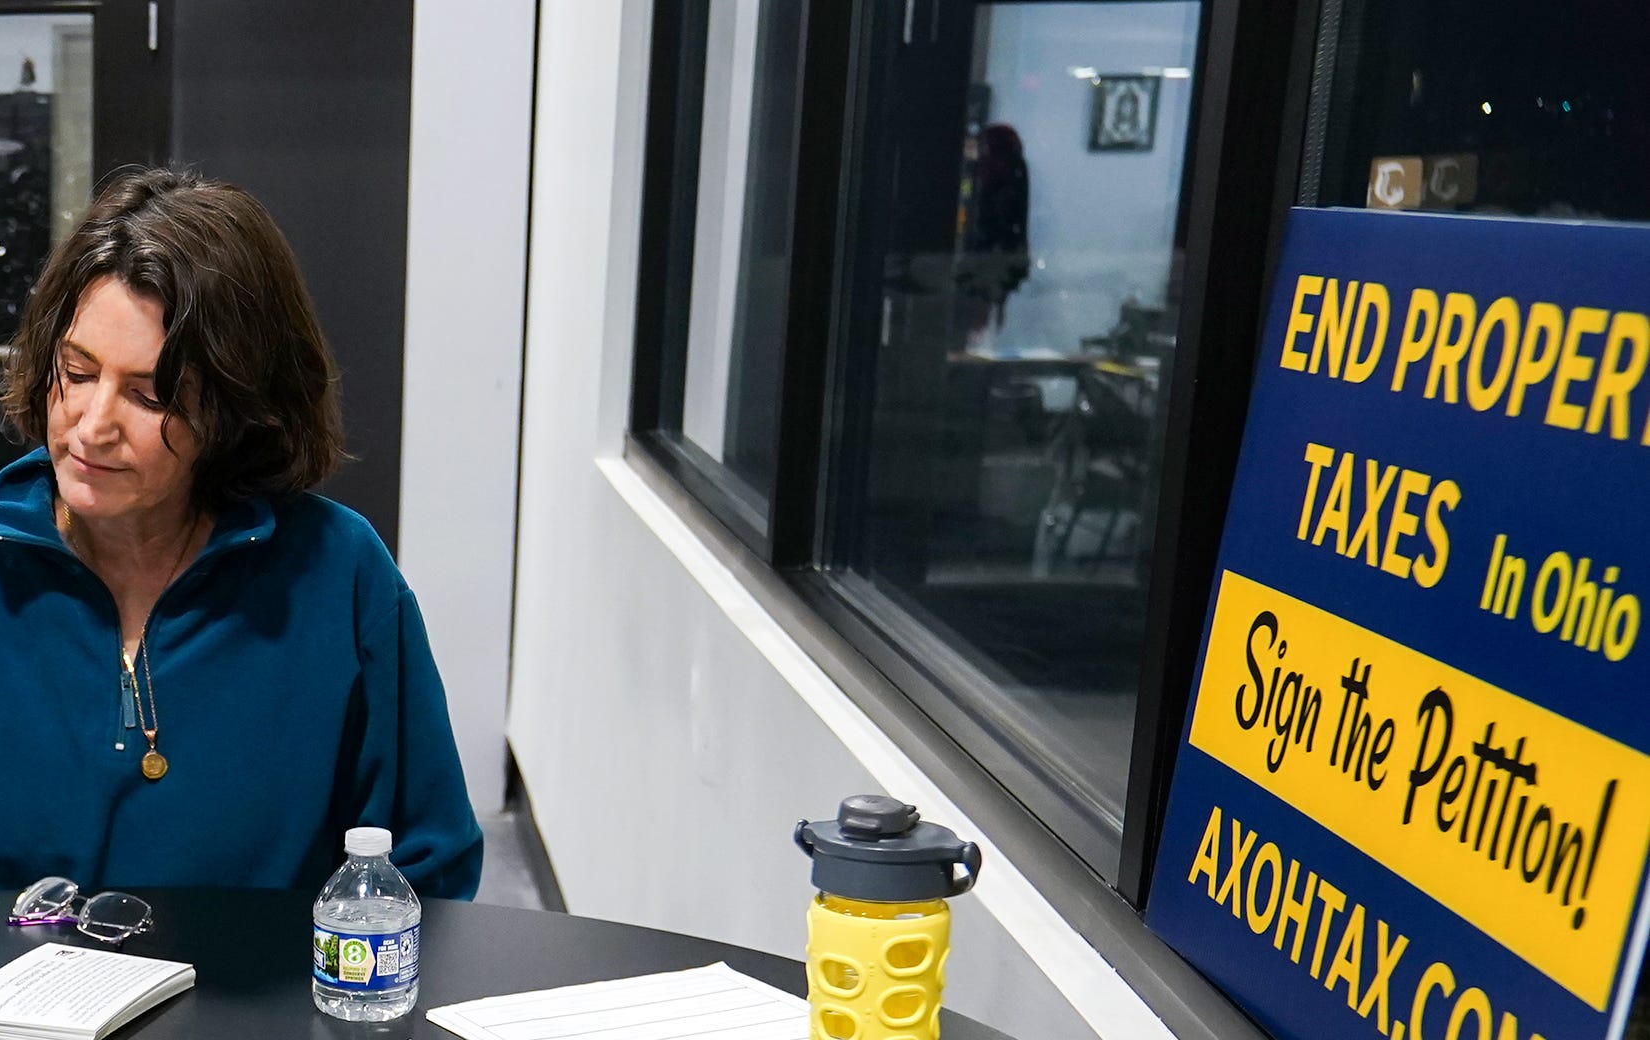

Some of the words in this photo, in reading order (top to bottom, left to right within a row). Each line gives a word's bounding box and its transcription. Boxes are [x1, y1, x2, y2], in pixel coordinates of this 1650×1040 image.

[1279, 274, 1391, 384] END
[1391, 287, 1650, 447] PROPER
[1296, 442, 1462, 588] TAXES
[1480, 533, 1527, 621] In
[1530, 550, 1641, 662] Ohio
[1235, 610, 1322, 773] Sign
[1330, 657, 1395, 791] the
[1402, 686, 1618, 931] Petition!
